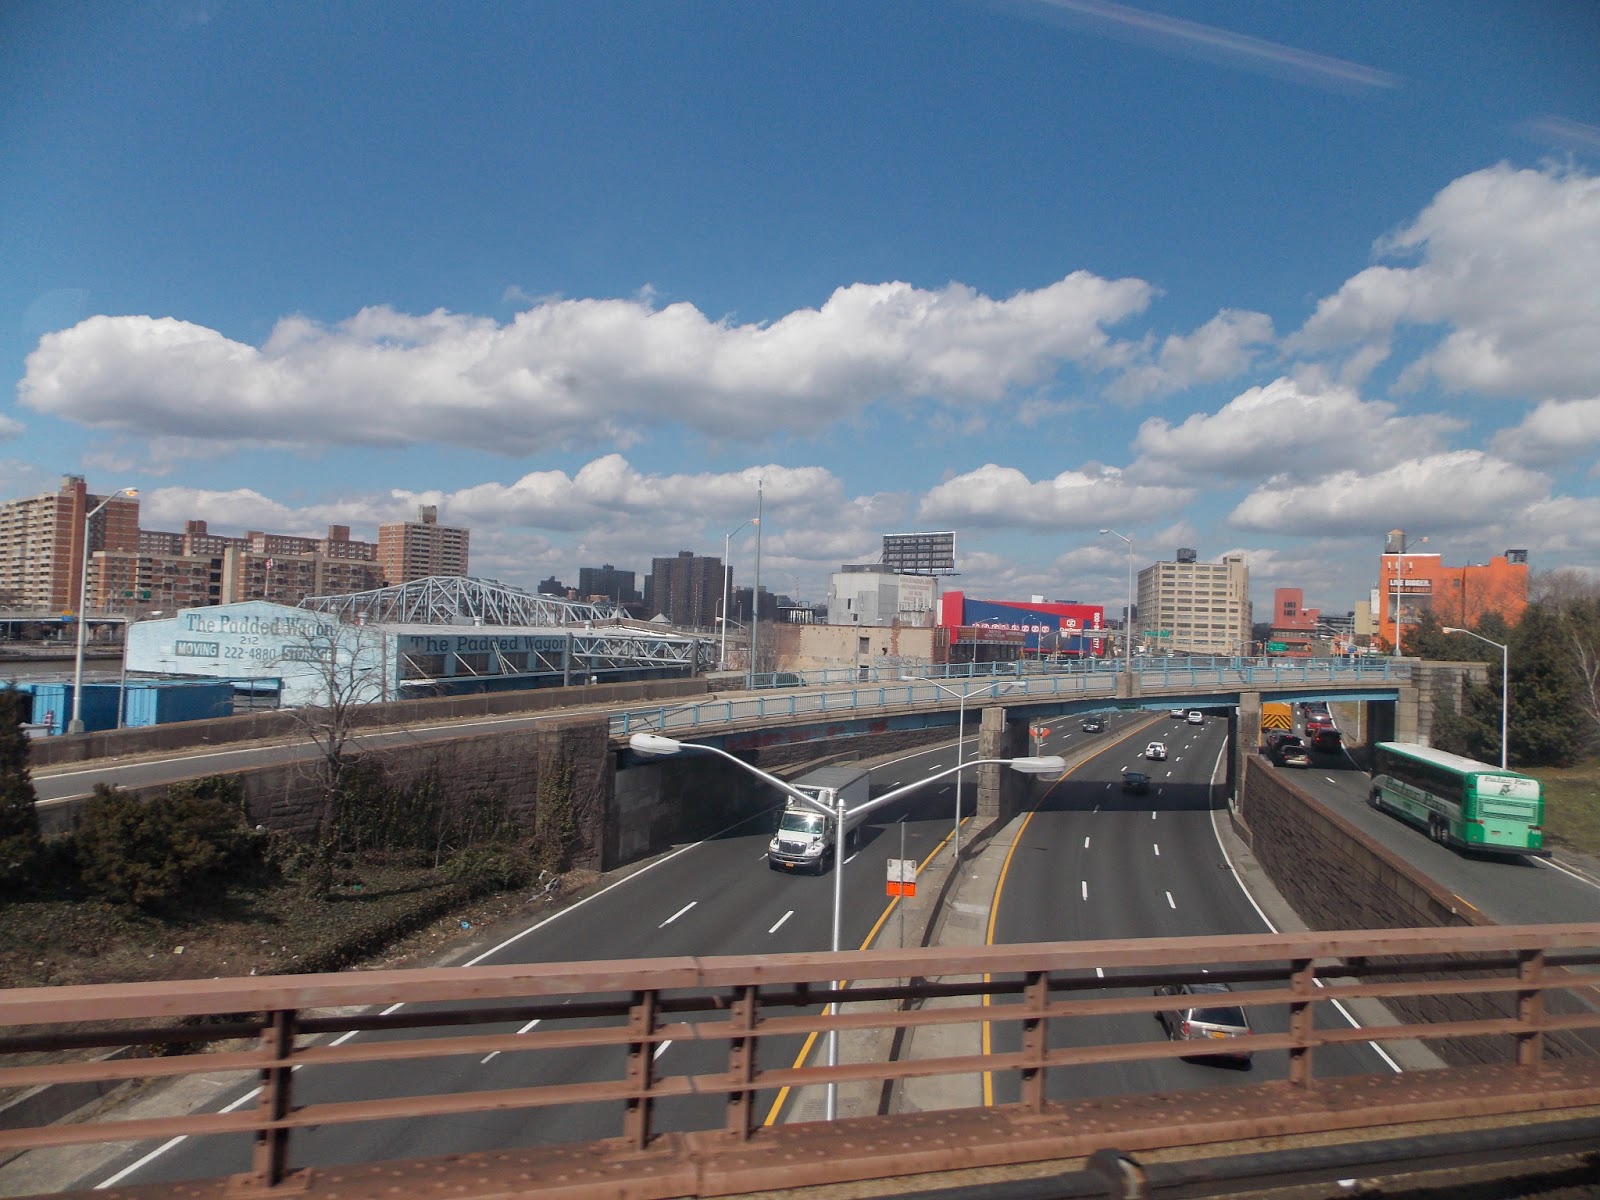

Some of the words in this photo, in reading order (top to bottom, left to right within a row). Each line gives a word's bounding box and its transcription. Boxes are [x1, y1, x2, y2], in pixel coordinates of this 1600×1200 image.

[187, 614, 215, 633] The
[219, 615, 280, 636] Padded
[240, 636, 259, 645] 212
[410, 636, 449, 651] The
[457, 636, 518, 651] Padded
[524, 636, 566, 651] Wagon
[177, 642, 217, 657] MOVING
[224, 646, 276, 661] 222-4880
[284, 648, 333, 662] STORAGE
